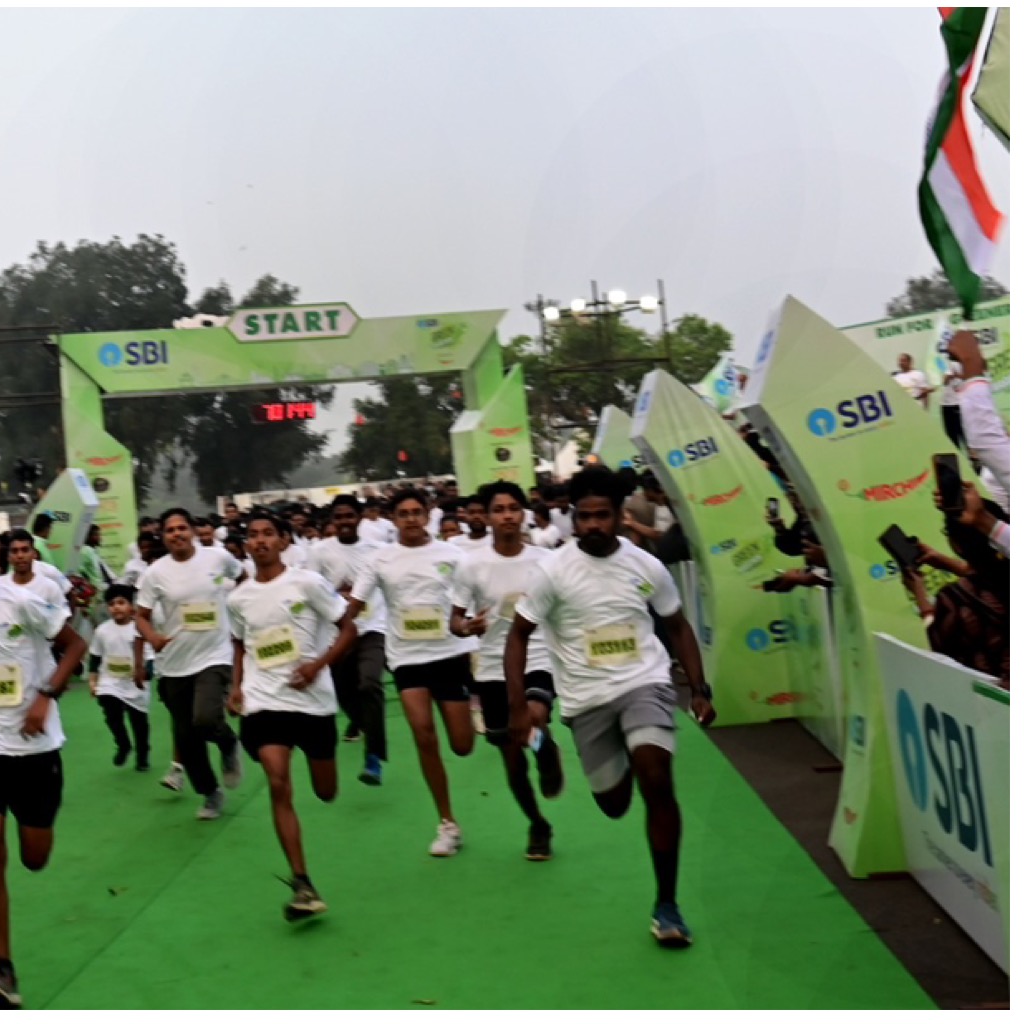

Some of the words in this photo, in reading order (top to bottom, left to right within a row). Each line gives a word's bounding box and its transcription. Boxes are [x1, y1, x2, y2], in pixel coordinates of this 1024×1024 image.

[245, 310, 340, 336] START
[125, 339, 169, 366] SBI
[837, 390, 893, 428] SBI
[684, 436, 719, 462] SBI
[923, 702, 994, 868] SBI
